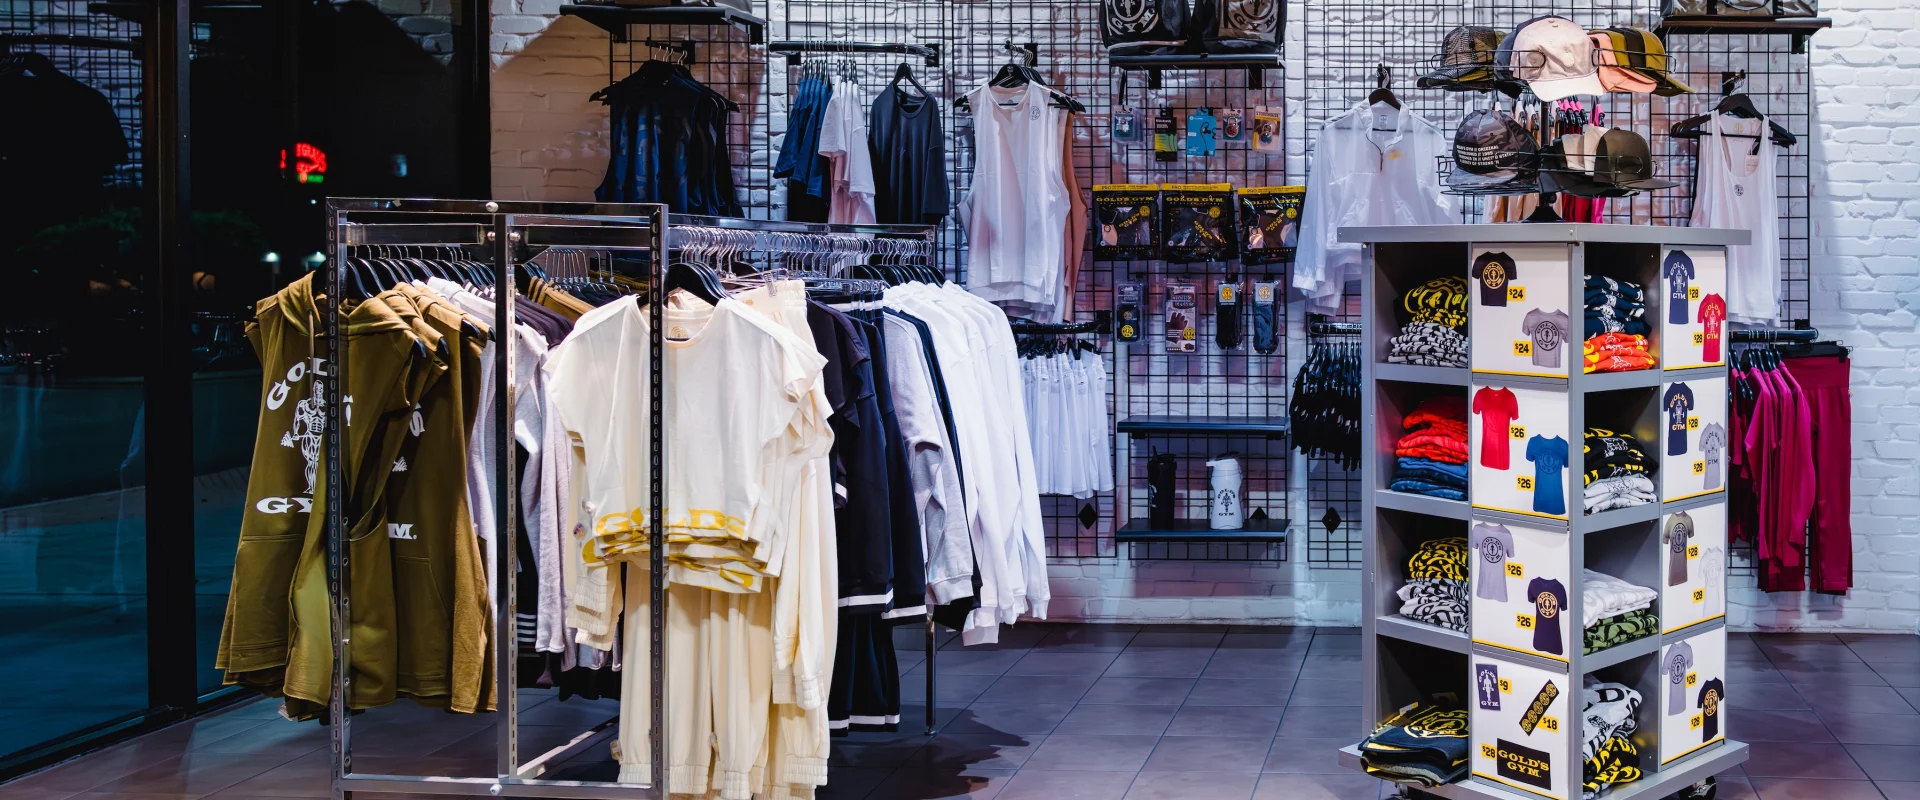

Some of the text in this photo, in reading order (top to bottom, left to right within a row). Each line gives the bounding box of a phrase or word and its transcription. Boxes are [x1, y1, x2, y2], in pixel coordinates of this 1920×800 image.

[1509, 289, 1523, 299] $24
[1515, 343, 1529, 353] $24
[1688, 419, 1698, 428] $28
[1511, 427, 1524, 438] $26
[1518, 478, 1531, 489] $26
[1508, 565, 1522, 576] $26
[1517, 616, 1531, 627] $26
[1500, 680, 1508, 690] $9
[1543, 718, 1558, 730] $18
[1482, 746, 1496, 758] $28
[1498, 750, 1549, 771] GOLD'S
